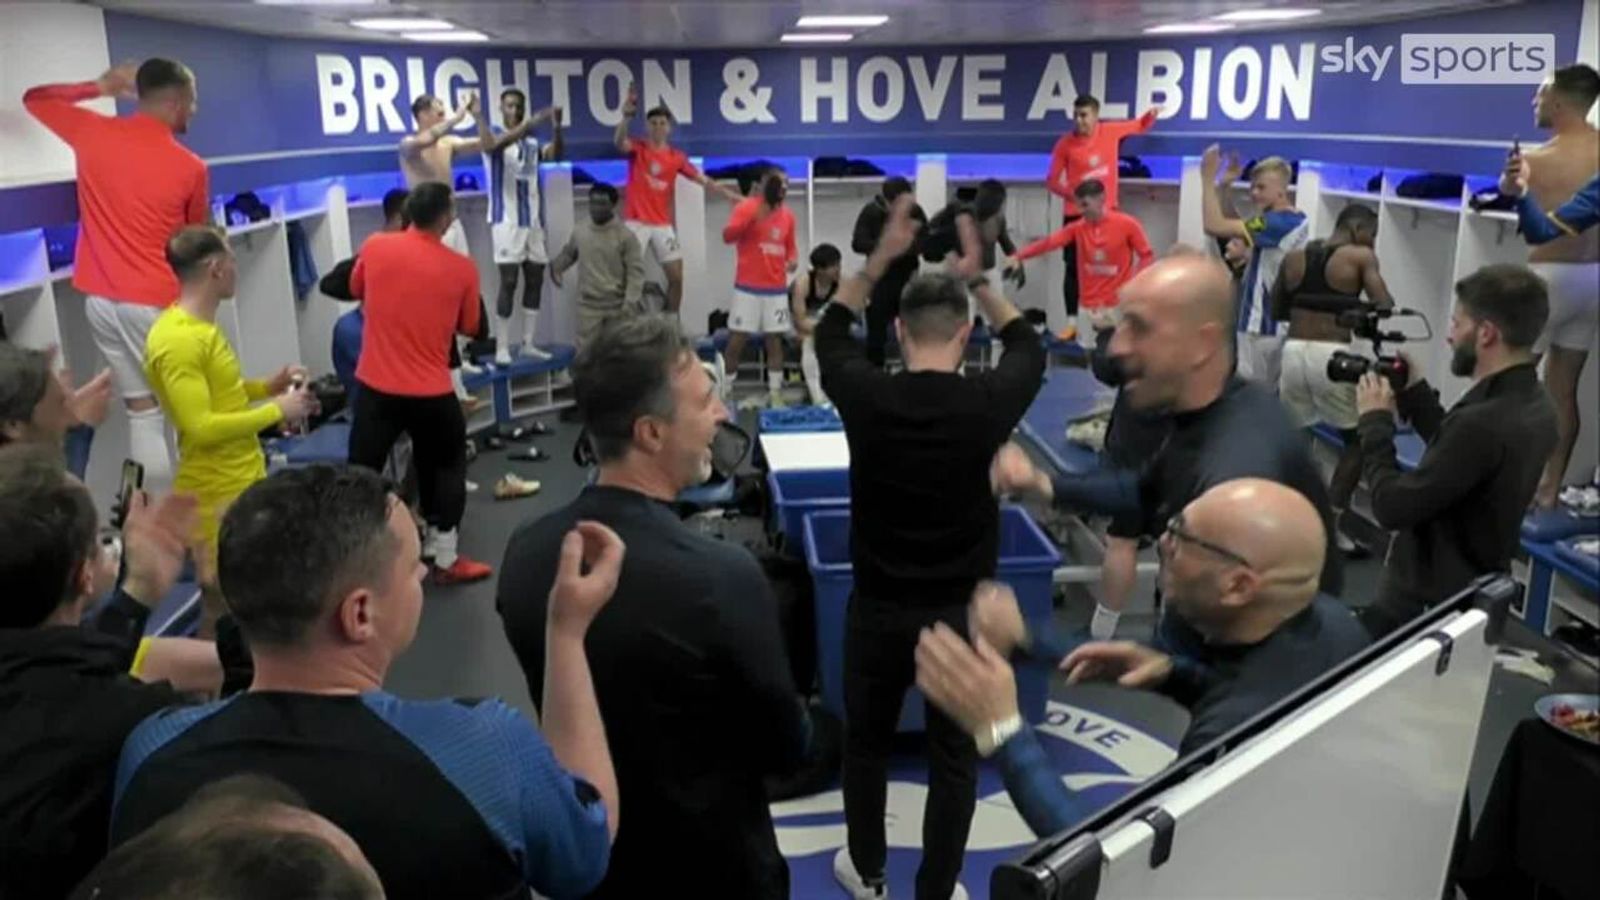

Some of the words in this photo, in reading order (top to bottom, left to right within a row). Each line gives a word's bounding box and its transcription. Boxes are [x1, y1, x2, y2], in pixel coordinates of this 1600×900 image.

[316, 54, 693, 135] BRIGHTON
[719, 57, 777, 123] &
[800, 55, 1006, 122] HOVE
[1026, 43, 1316, 120] ALBION
